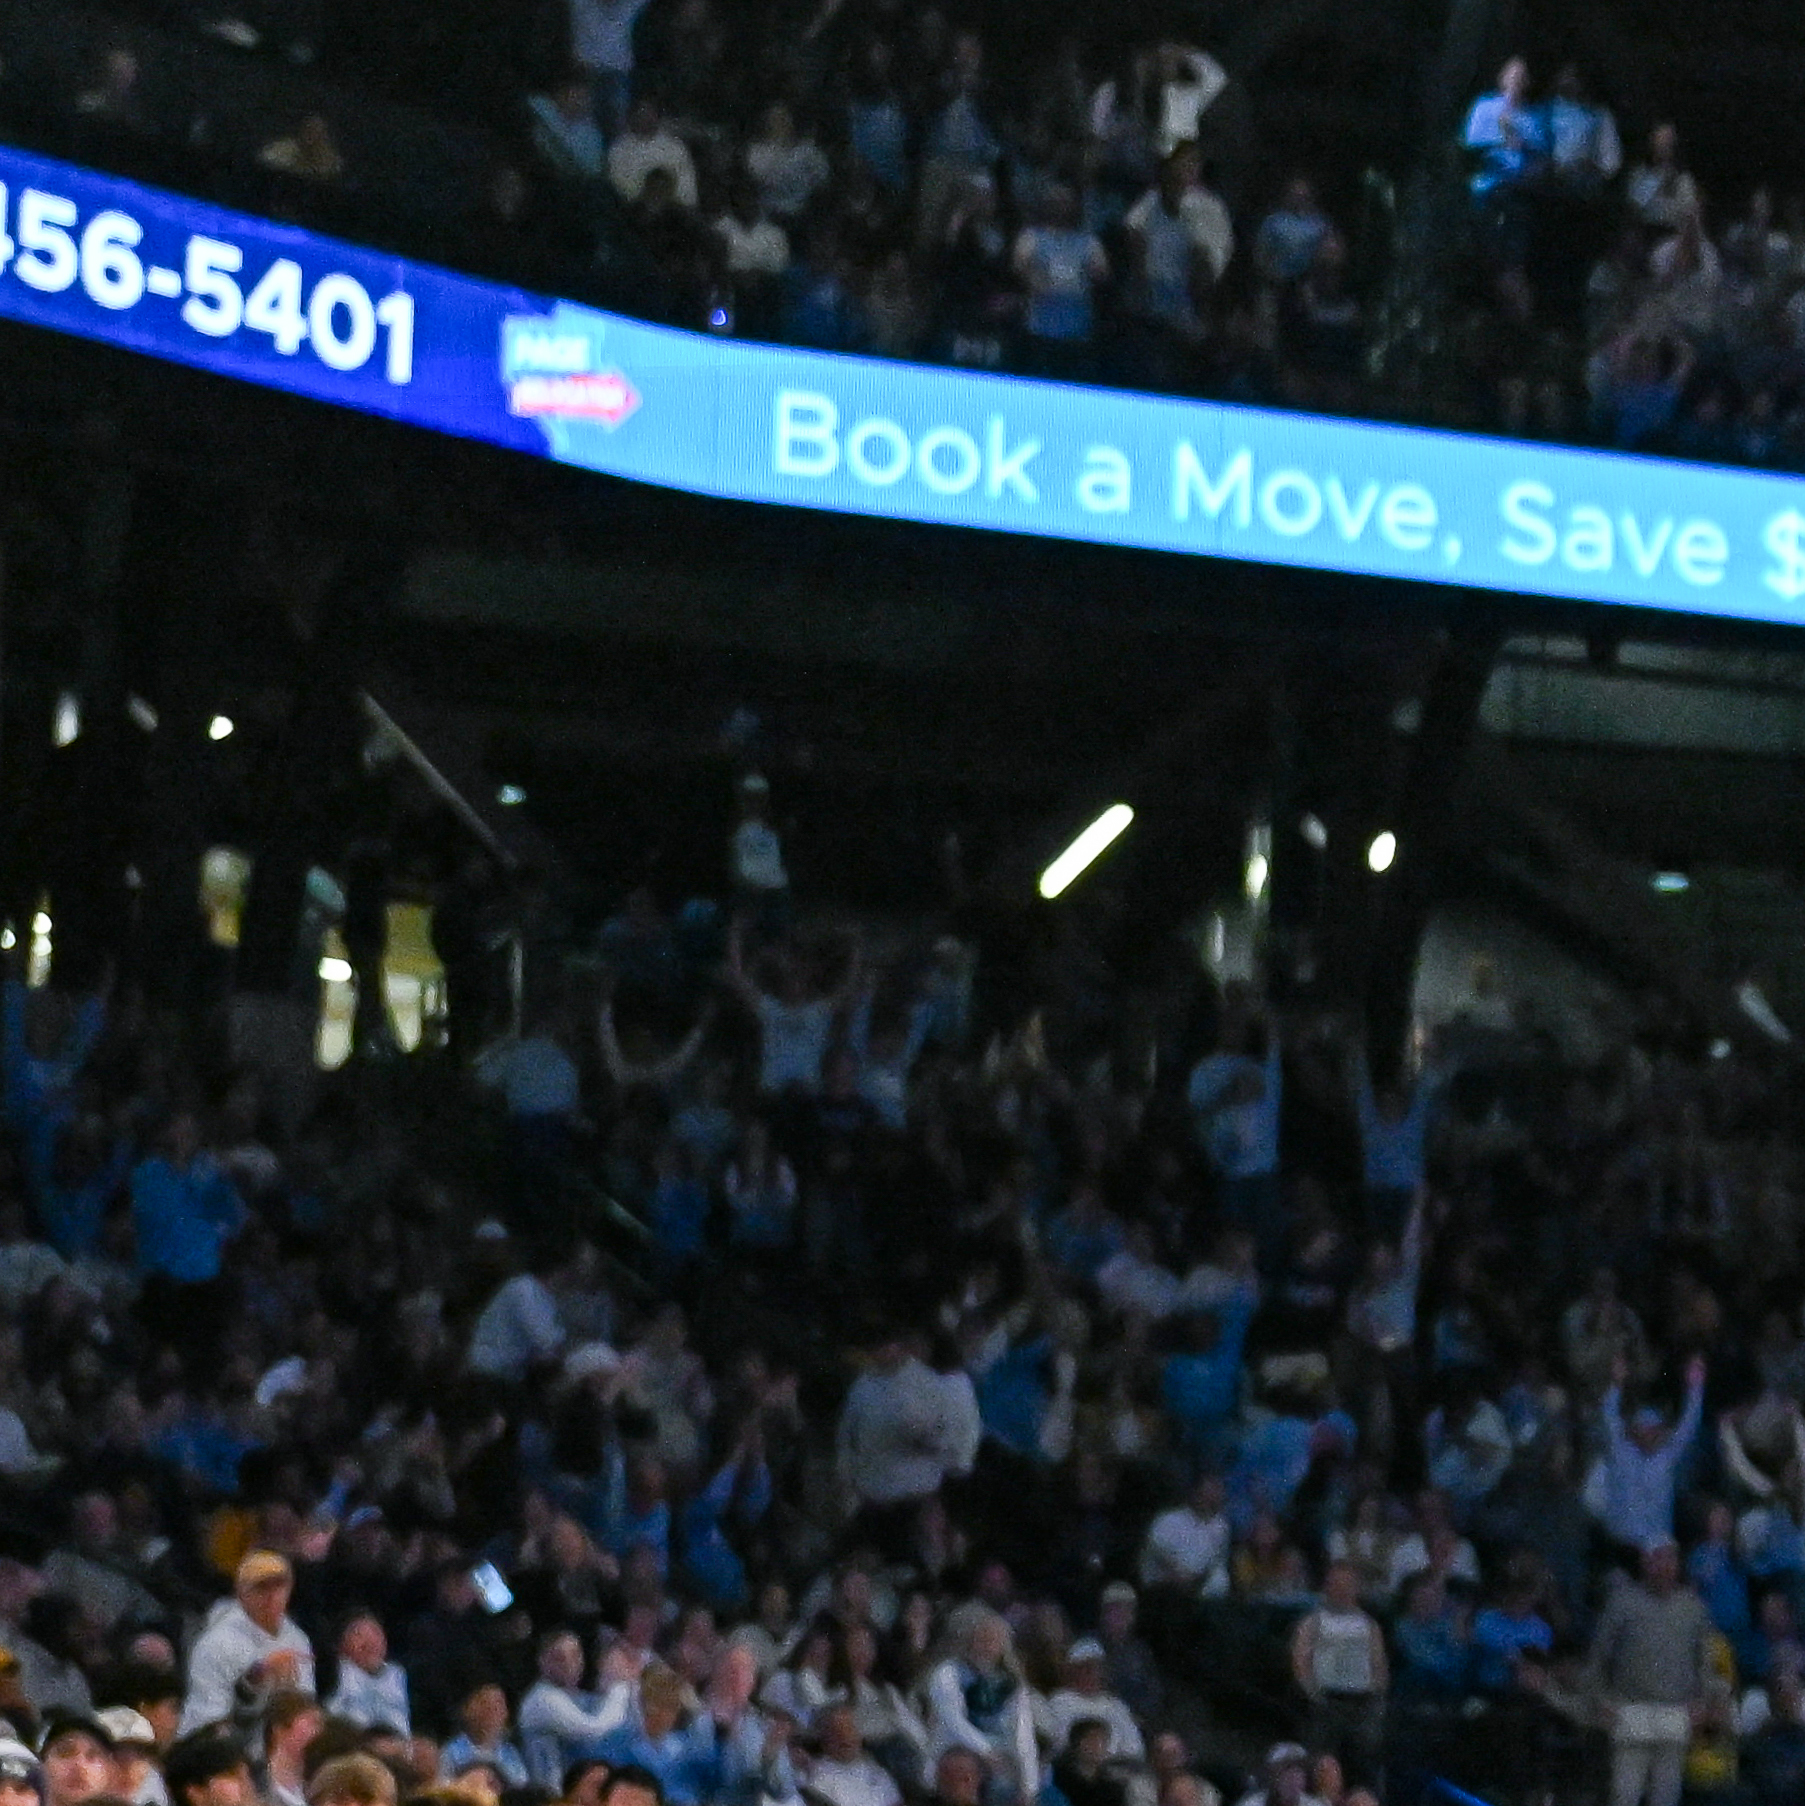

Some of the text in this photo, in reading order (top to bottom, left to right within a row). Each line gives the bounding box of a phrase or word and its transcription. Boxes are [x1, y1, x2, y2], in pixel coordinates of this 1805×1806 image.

[0, 178, 415, 385] 56-5401
[771, 386, 1043, 505] Book
[1075, 438, 1132, 516] a
[1171, 438, 1464, 567] Move,
[1499, 478, 1731, 588] Save
